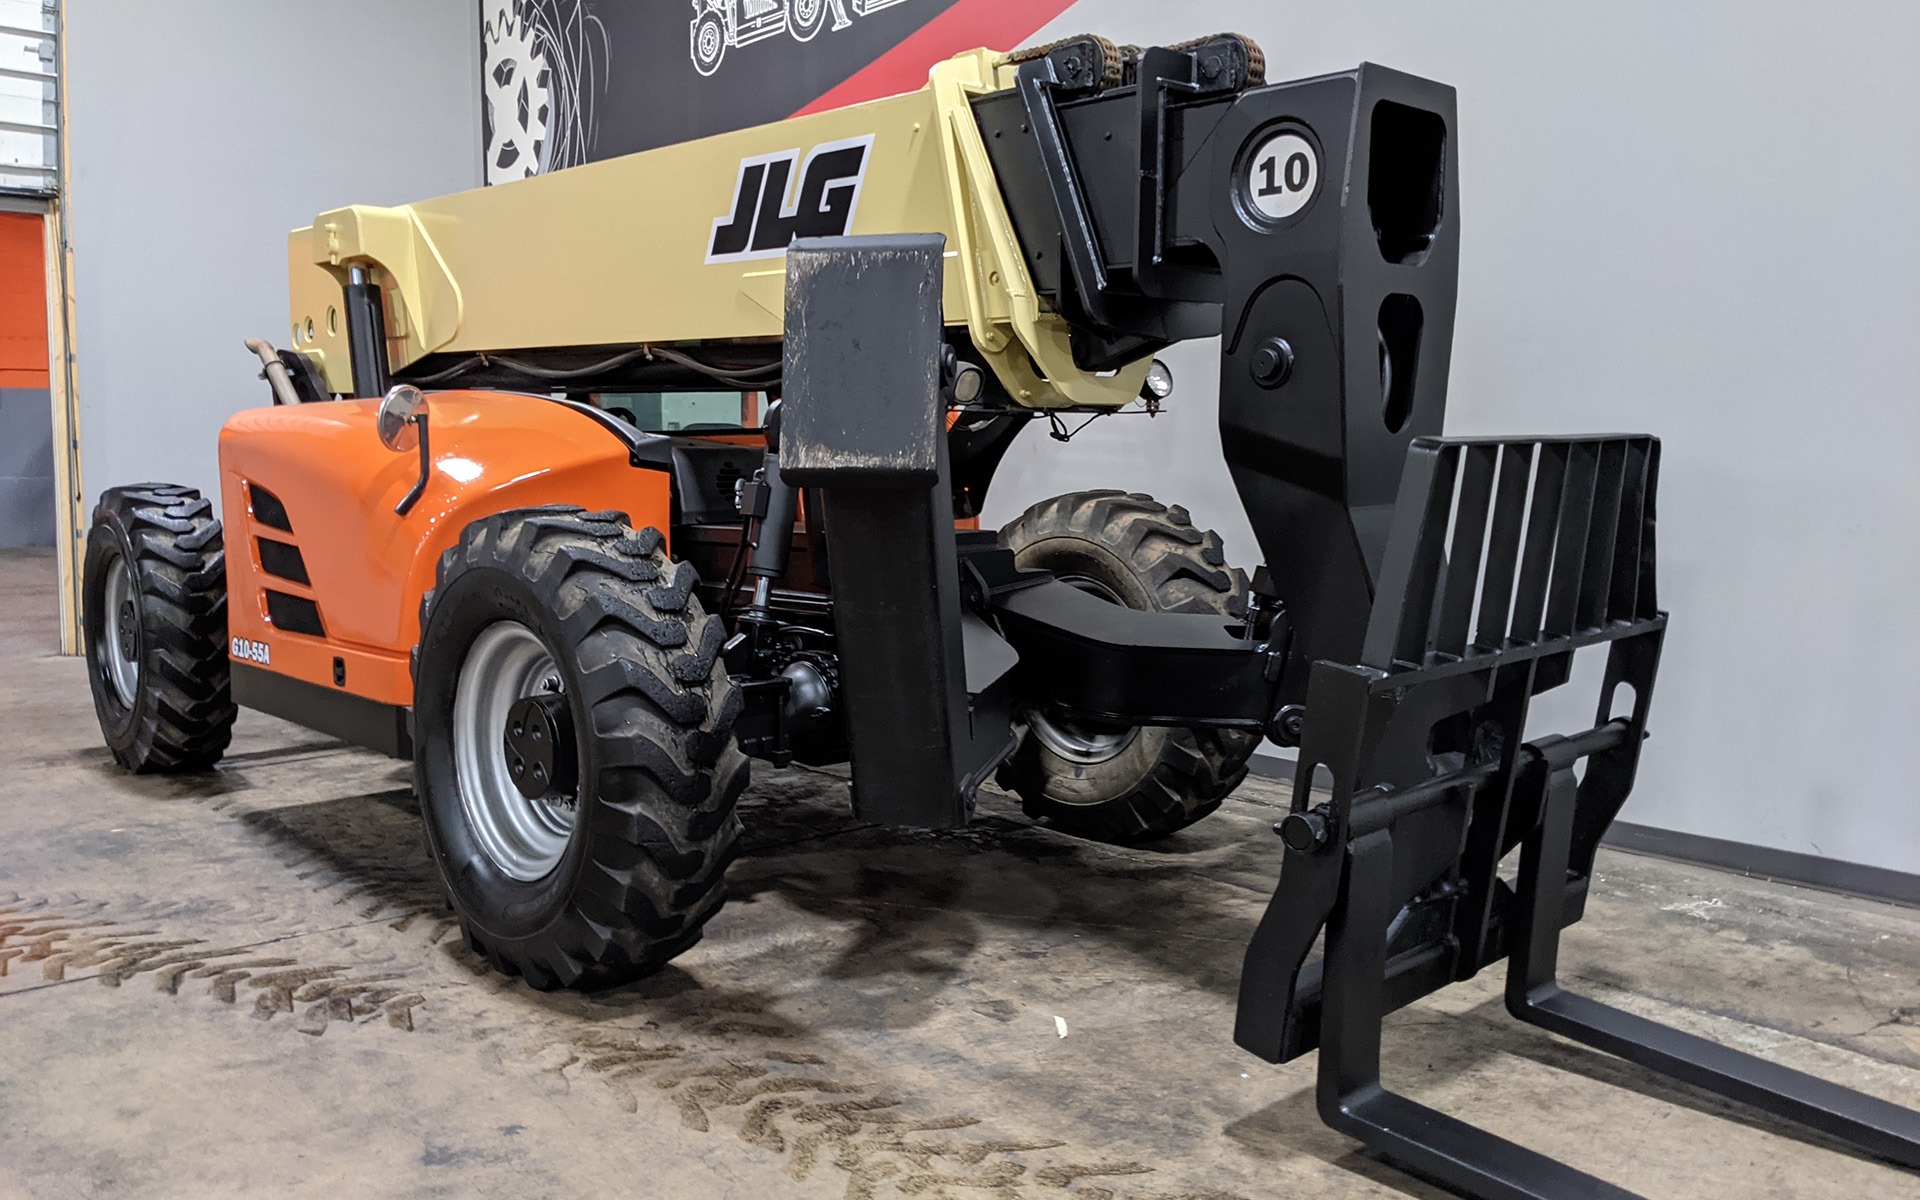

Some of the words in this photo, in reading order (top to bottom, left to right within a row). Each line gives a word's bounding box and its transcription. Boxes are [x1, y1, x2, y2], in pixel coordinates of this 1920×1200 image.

[1258, 151, 1310, 197] 10
[710, 144, 867, 256] JLG
[231, 636, 270, 665] G10-55A
